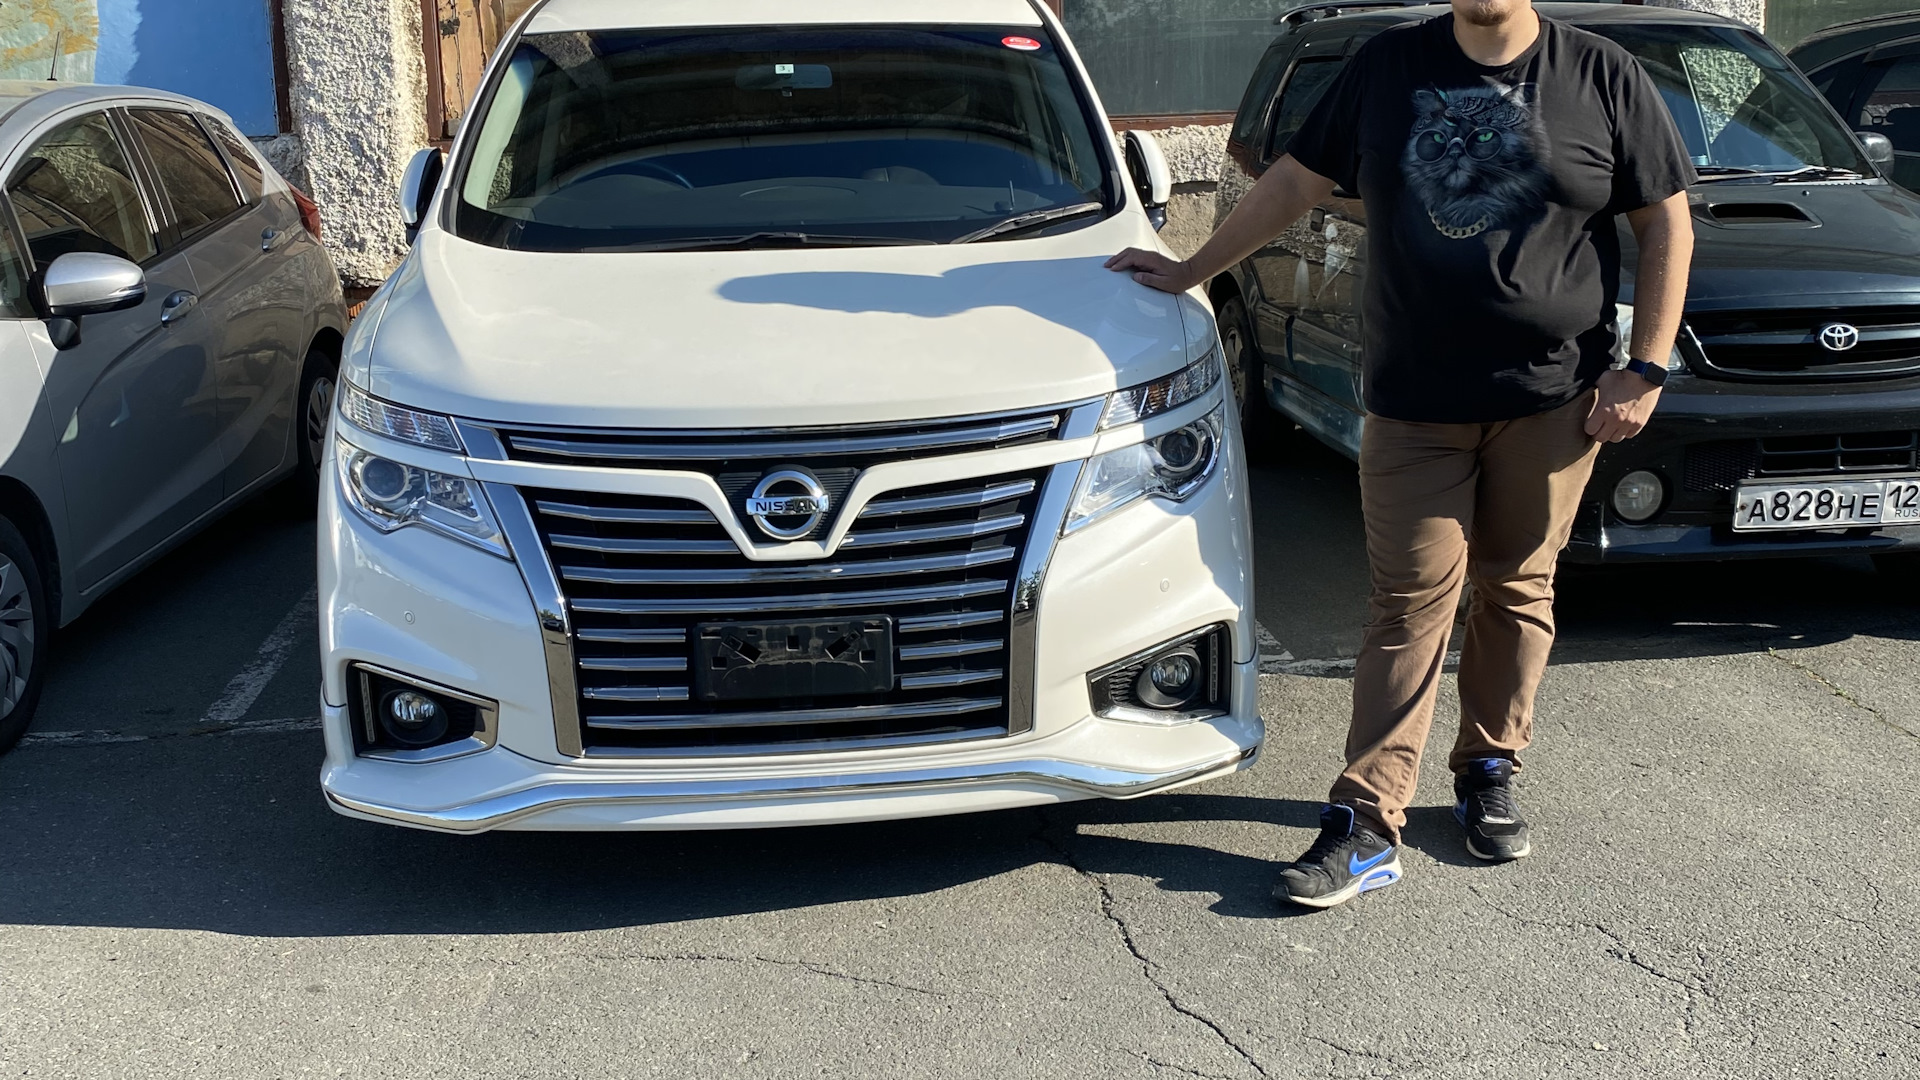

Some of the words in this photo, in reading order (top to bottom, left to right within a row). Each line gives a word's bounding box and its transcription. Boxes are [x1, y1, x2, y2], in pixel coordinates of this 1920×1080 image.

[755, 500, 819, 512] NISSAN
[1748, 489, 1879, 523] A828HE
[1895, 508, 1918, 517] RUS
